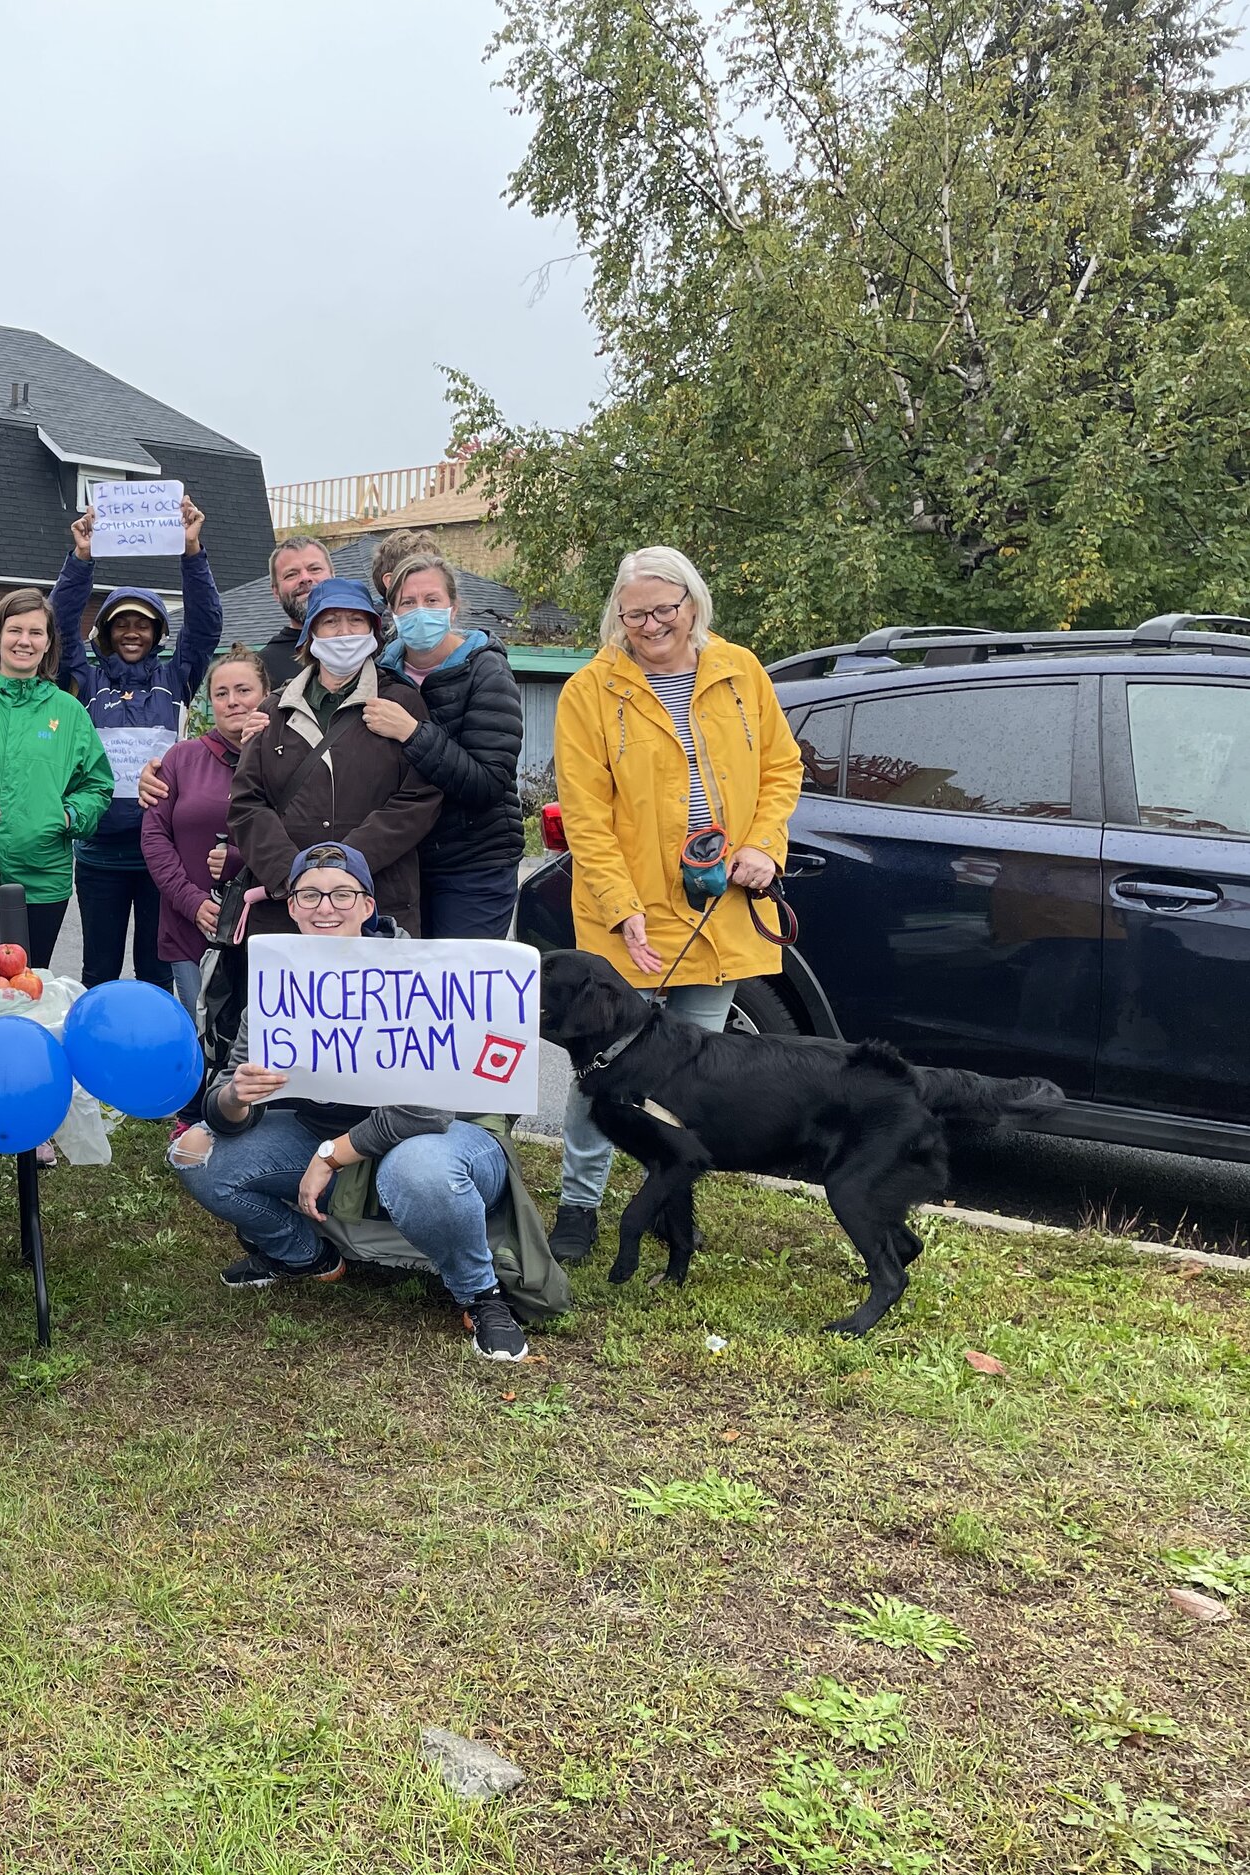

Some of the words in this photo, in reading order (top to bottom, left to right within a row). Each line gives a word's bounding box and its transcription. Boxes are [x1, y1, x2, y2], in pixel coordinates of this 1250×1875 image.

[97, 485, 108, 499] 1
[113, 484, 166, 496] MILLION
[97, 503, 134, 517] STEPS
[140, 503, 150, 513] 4
[154, 501, 181, 512] OCD
[92, 519, 156, 531] COMMUNITY
[117, 534, 153, 545] 2021
[111, 756, 140, 764] ANADA
[258, 968, 536, 1024] UNCERTAINTY
[263, 1027, 298, 1070] IS
[311, 1026, 363, 1073] MY
[376, 1023, 460, 1072] JAM
